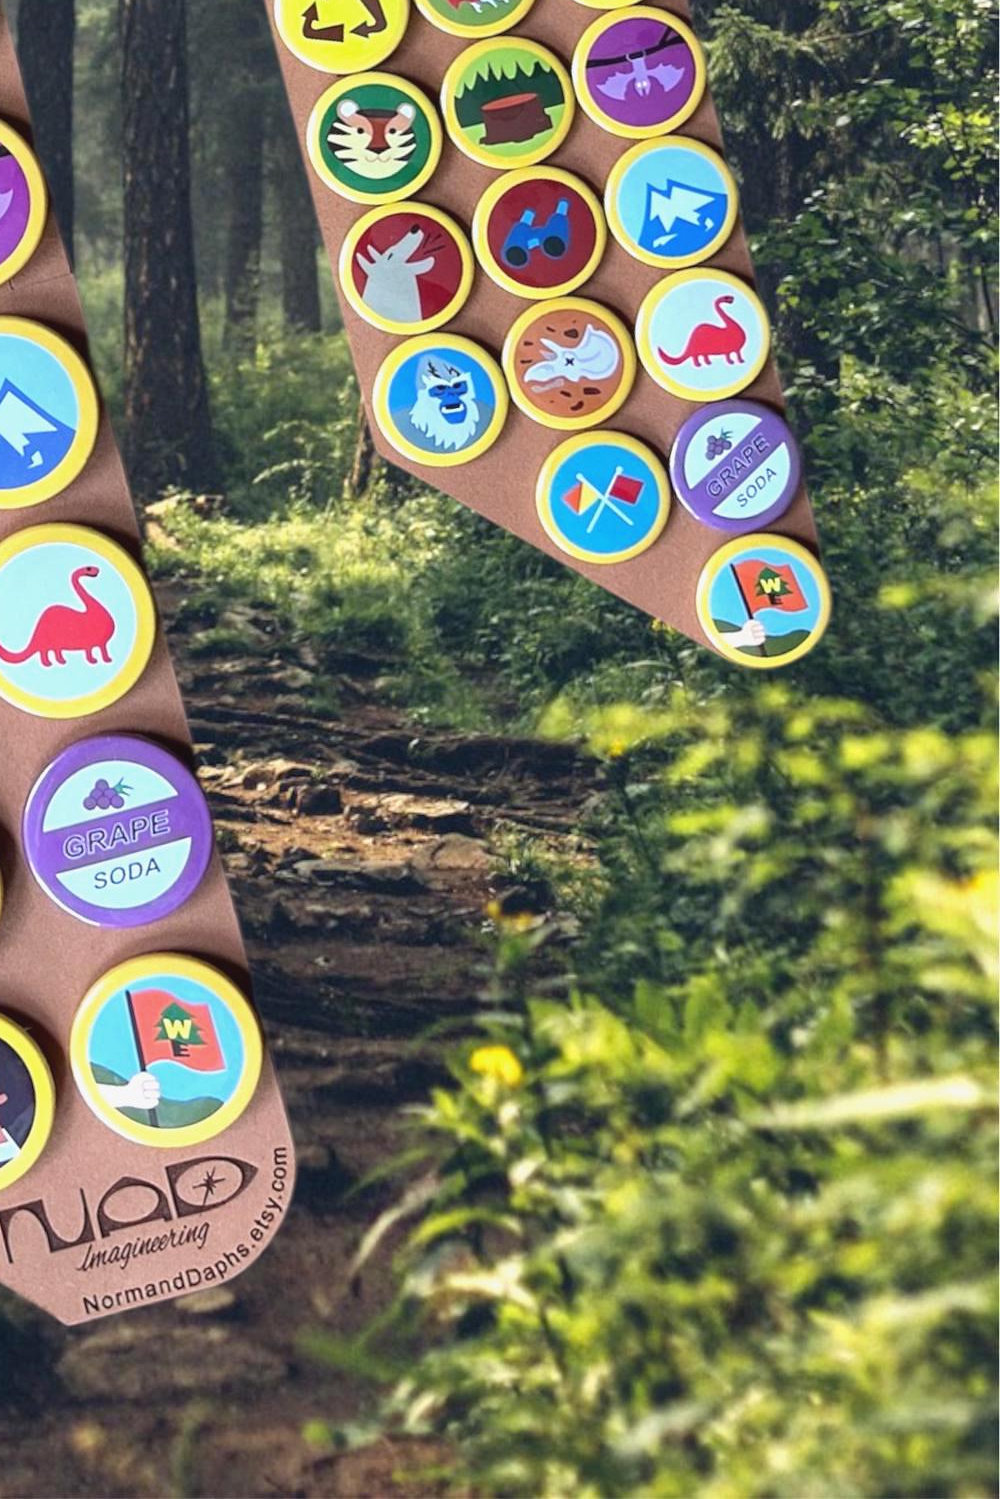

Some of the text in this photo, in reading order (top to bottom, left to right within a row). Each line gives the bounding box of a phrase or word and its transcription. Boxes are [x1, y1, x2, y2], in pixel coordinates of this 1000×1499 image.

[707, 434, 770, 497] GRAPE
[736, 467, 777, 508] SODA
[760, 578, 781, 593] W
[63, 810, 170, 860] GRAPE
[94, 857, 161, 890] SODA
[162, 1018, 192, 1040] W
[76, 1221, 210, 1272] Imagineering
[83, 1146, 287, 1314] NormandDaphs.etsy.com
